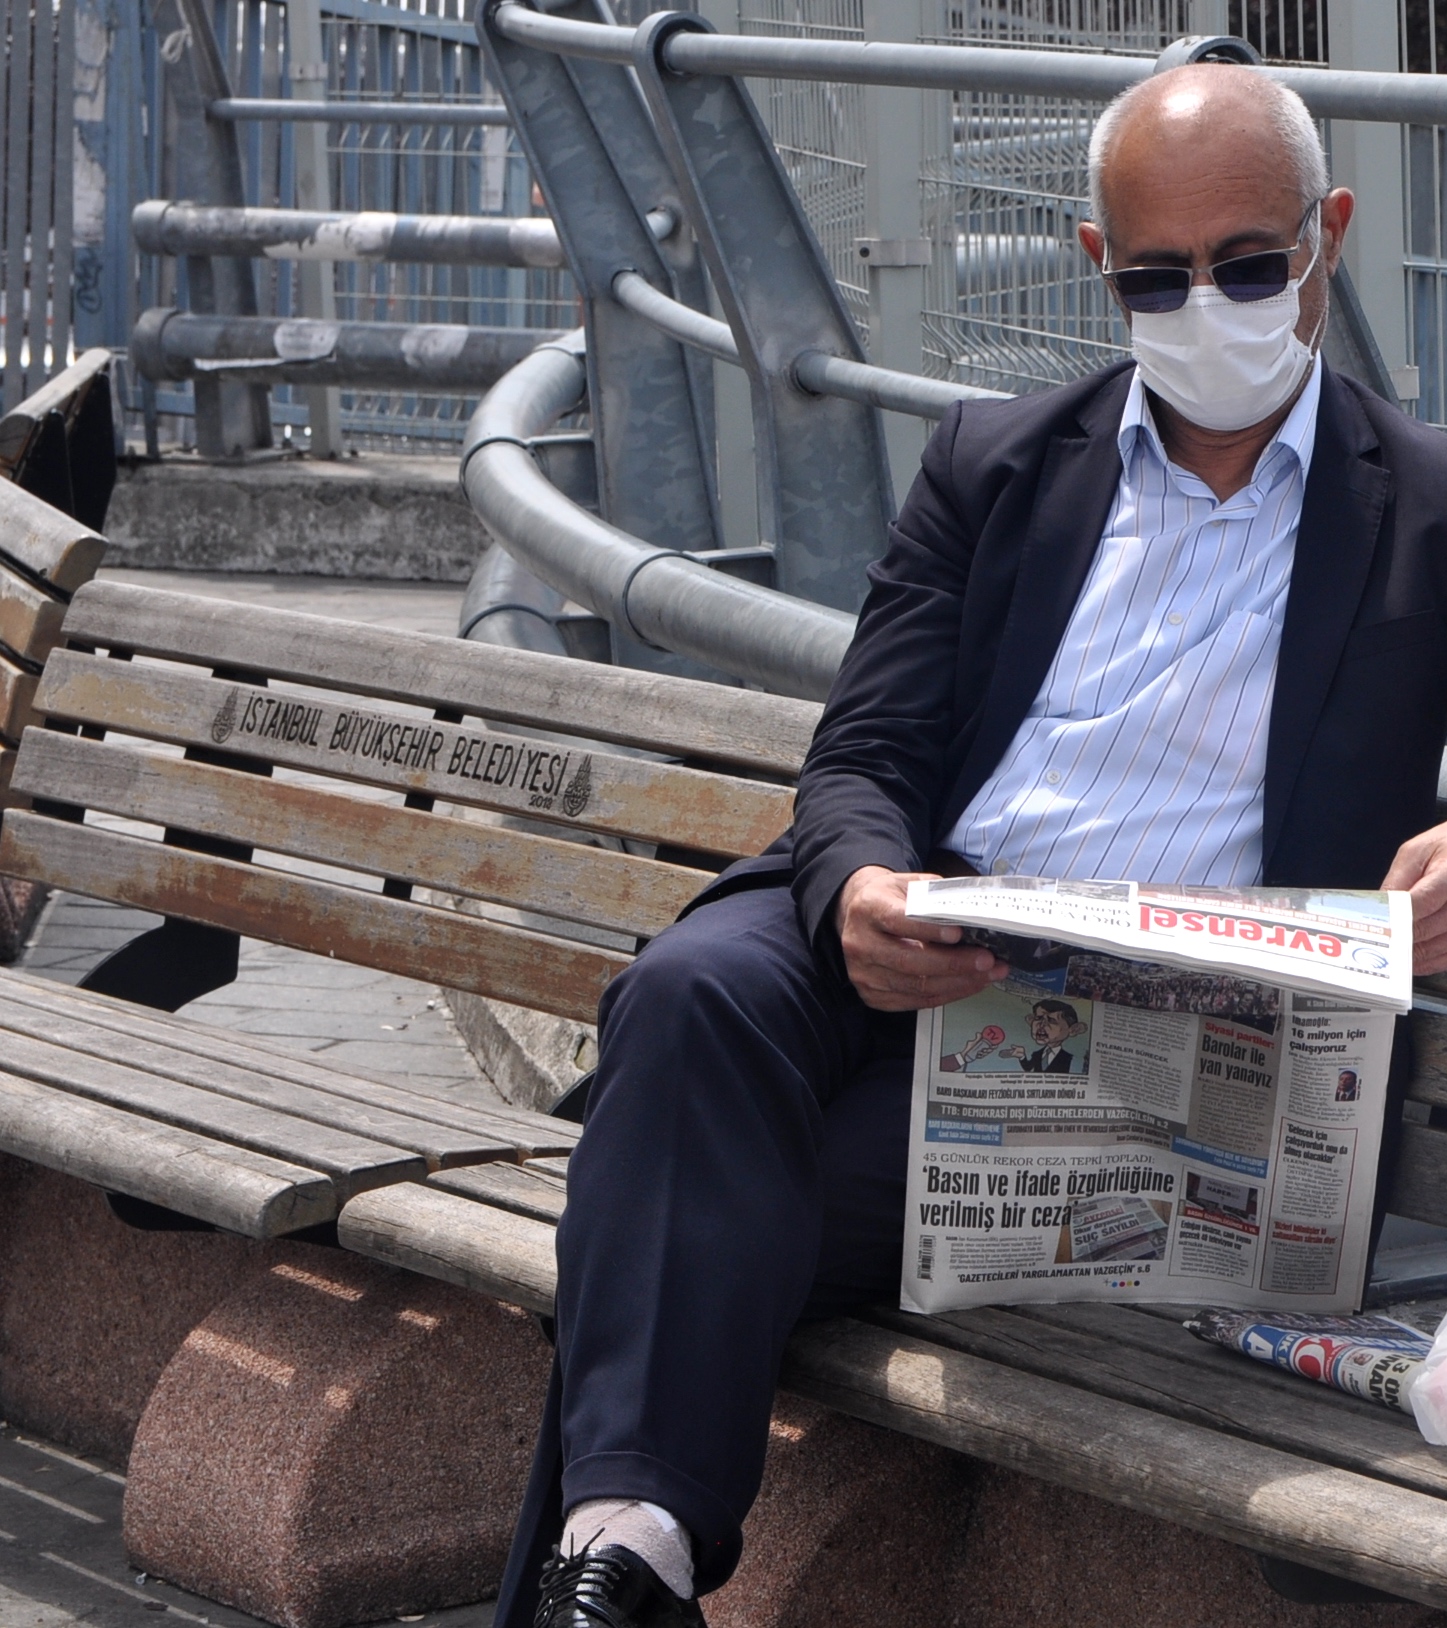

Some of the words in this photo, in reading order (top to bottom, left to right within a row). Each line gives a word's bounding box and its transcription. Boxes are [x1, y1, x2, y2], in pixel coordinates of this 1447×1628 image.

[239, 690, 323, 747] İSTANBUL
[329, 710, 445, 772] BÜYÜKŞEHİR
[447, 736, 572, 797] BELEDİYESİ
[1139, 905, 1342, 957] evrensel
[1236, 1032, 1275, 1049] partiler:
[1291, 1027, 1304, 1038] 16
[1307, 1030, 1343, 1041] milyon
[1347, 1029, 1366, 1041] için
[1202, 1034, 1248, 1061] Barolar
[1250, 1049, 1265, 1067] ile
[1290, 1041, 1347, 1055] çalışıyoruz
[1200, 1057, 1221, 1076] yan
[1226, 1063, 1273, 1088] yanayız
[941, 1104, 960, 1116] TTB:
[962, 1106, 1008, 1119] DEMOKRASİ
[1009, 1108, 1026, 1120] DIŞI
[1027, 1106, 1104, 1119] DÜZENLEMELERDEN
[1106, 1109, 1155, 1125] VAZGEÇİLSİN
[923, 1153, 937, 1162] 45
[940, 1152, 990, 1164] GÜNLÜK
[993, 1156, 1034, 1166] REKOR
[1037, 1156, 1067, 1166] CEZA
[1070, 1154, 1102, 1166] TEPKİ
[1104, 1153, 1155, 1164] TOPLADI:
[1339, 1145, 1348, 1155] da
[987, 1175, 1008, 1197] ve
[1014, 1170, 1060, 1196] ifade
[1066, 1166, 1175, 1198] özgürlüğüne
[920, 1201, 995, 1232] verilmiş
[1001, 1202, 1026, 1229] bir
[1074, 1231, 1099, 1246] SUÇ
[1101, 1219, 1140, 1238] SAYILDI
[1021, 1267, 1091, 1280] YARGILAMAKTAN
[1137, 1264, 1151, 1273] s.6
